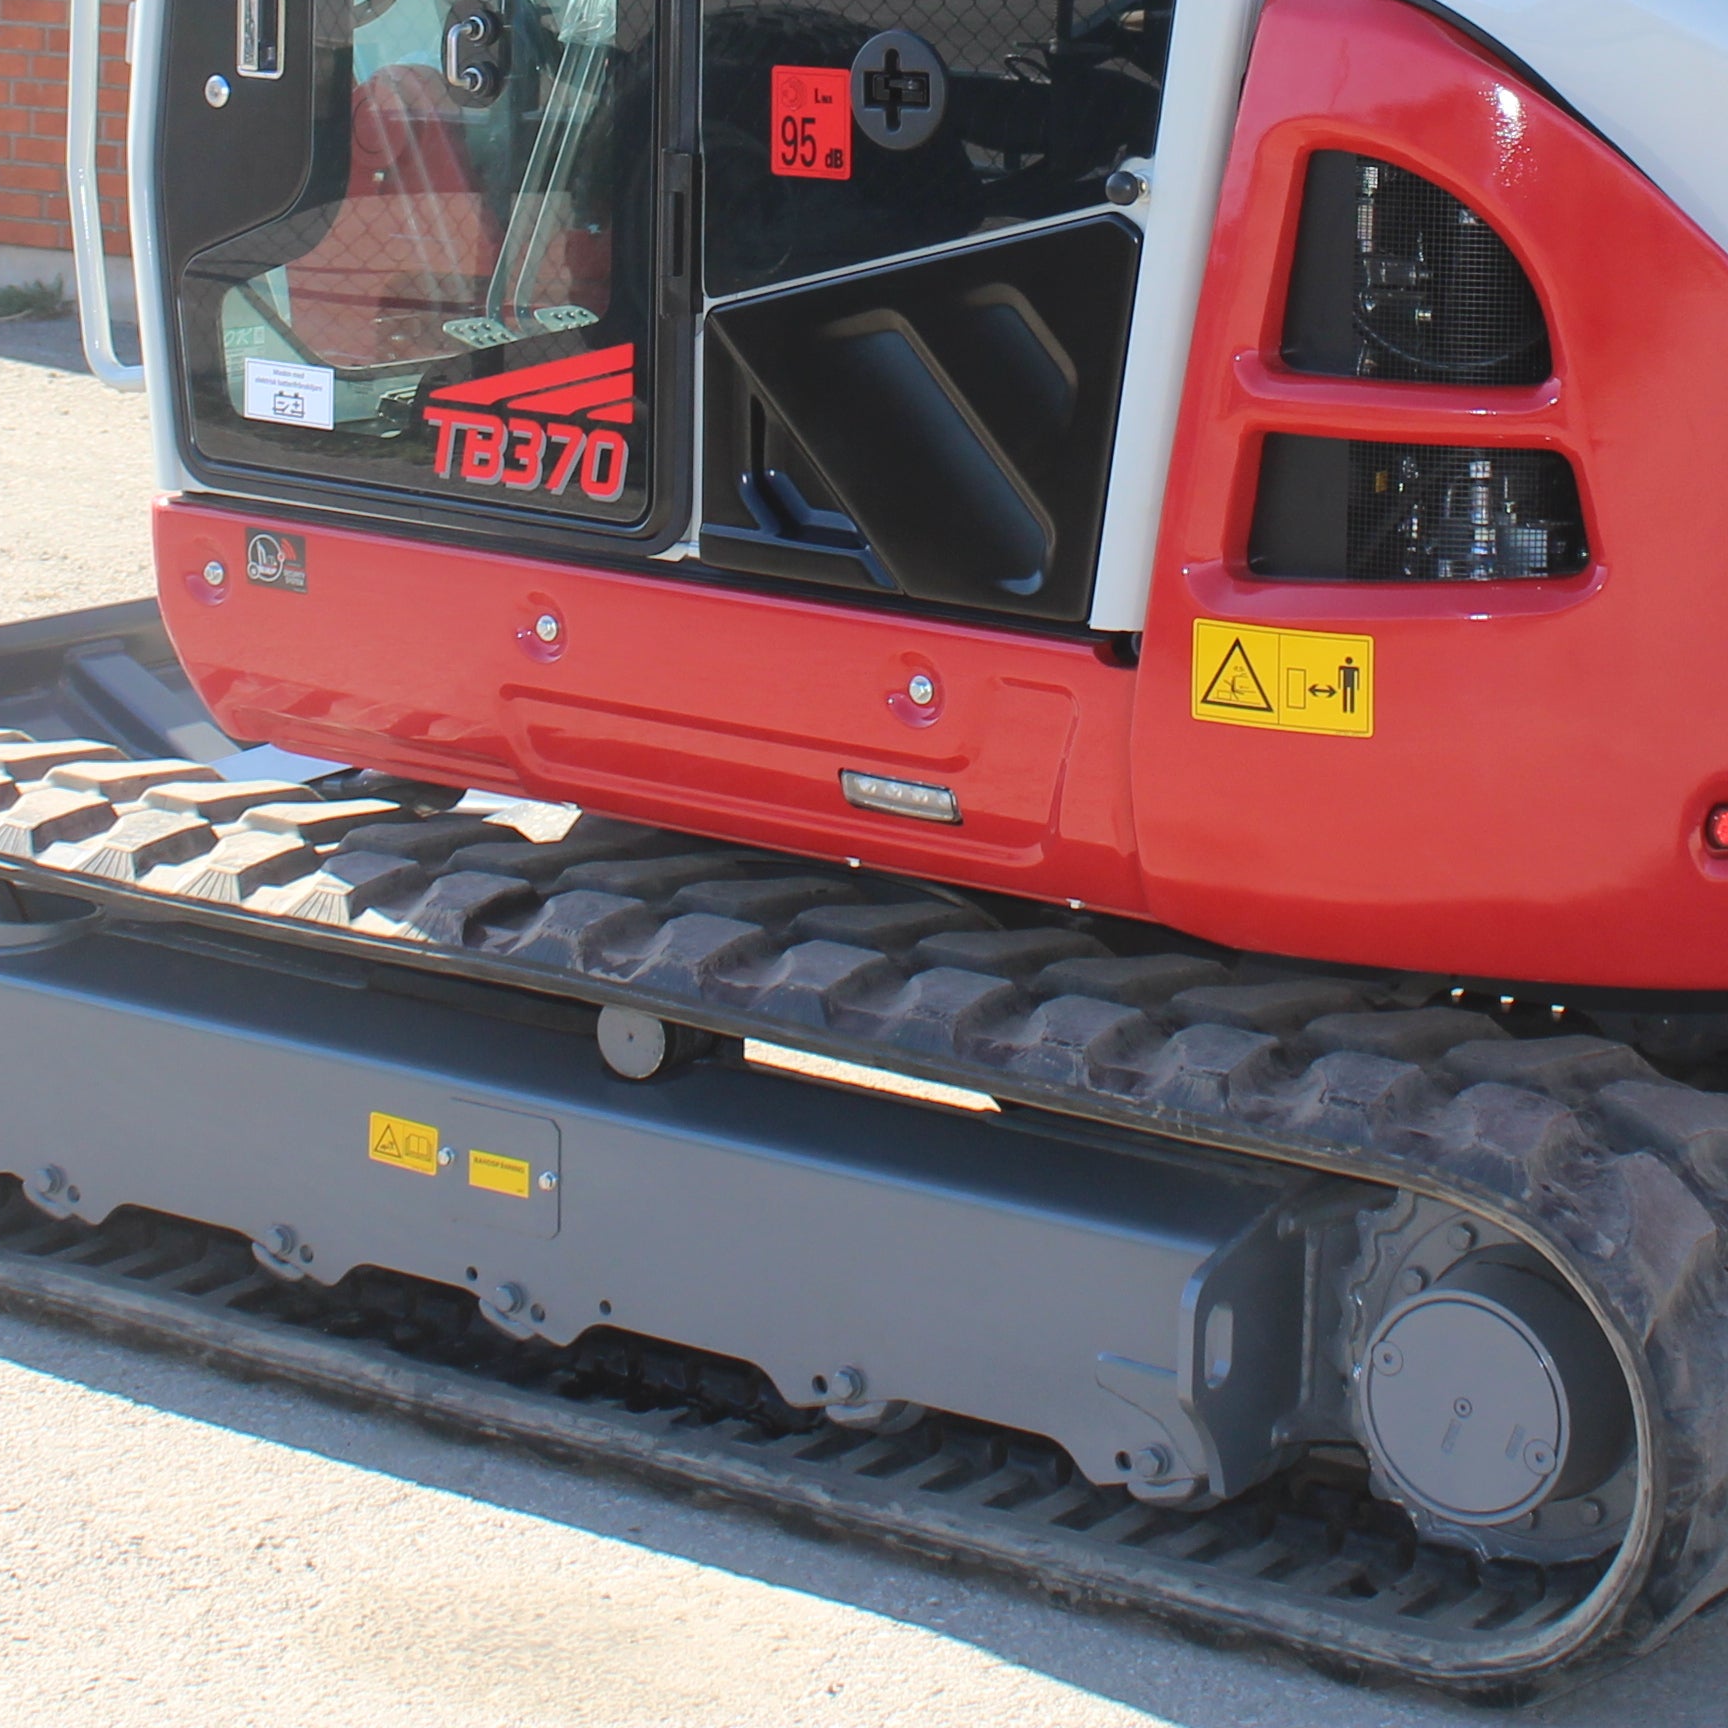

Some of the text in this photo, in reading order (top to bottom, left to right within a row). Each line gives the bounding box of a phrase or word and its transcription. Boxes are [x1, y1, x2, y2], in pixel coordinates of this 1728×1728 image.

[780, 115, 817, 168] 95
[824, 147, 844, 169] dB
[422, 404, 630, 503] TB370
